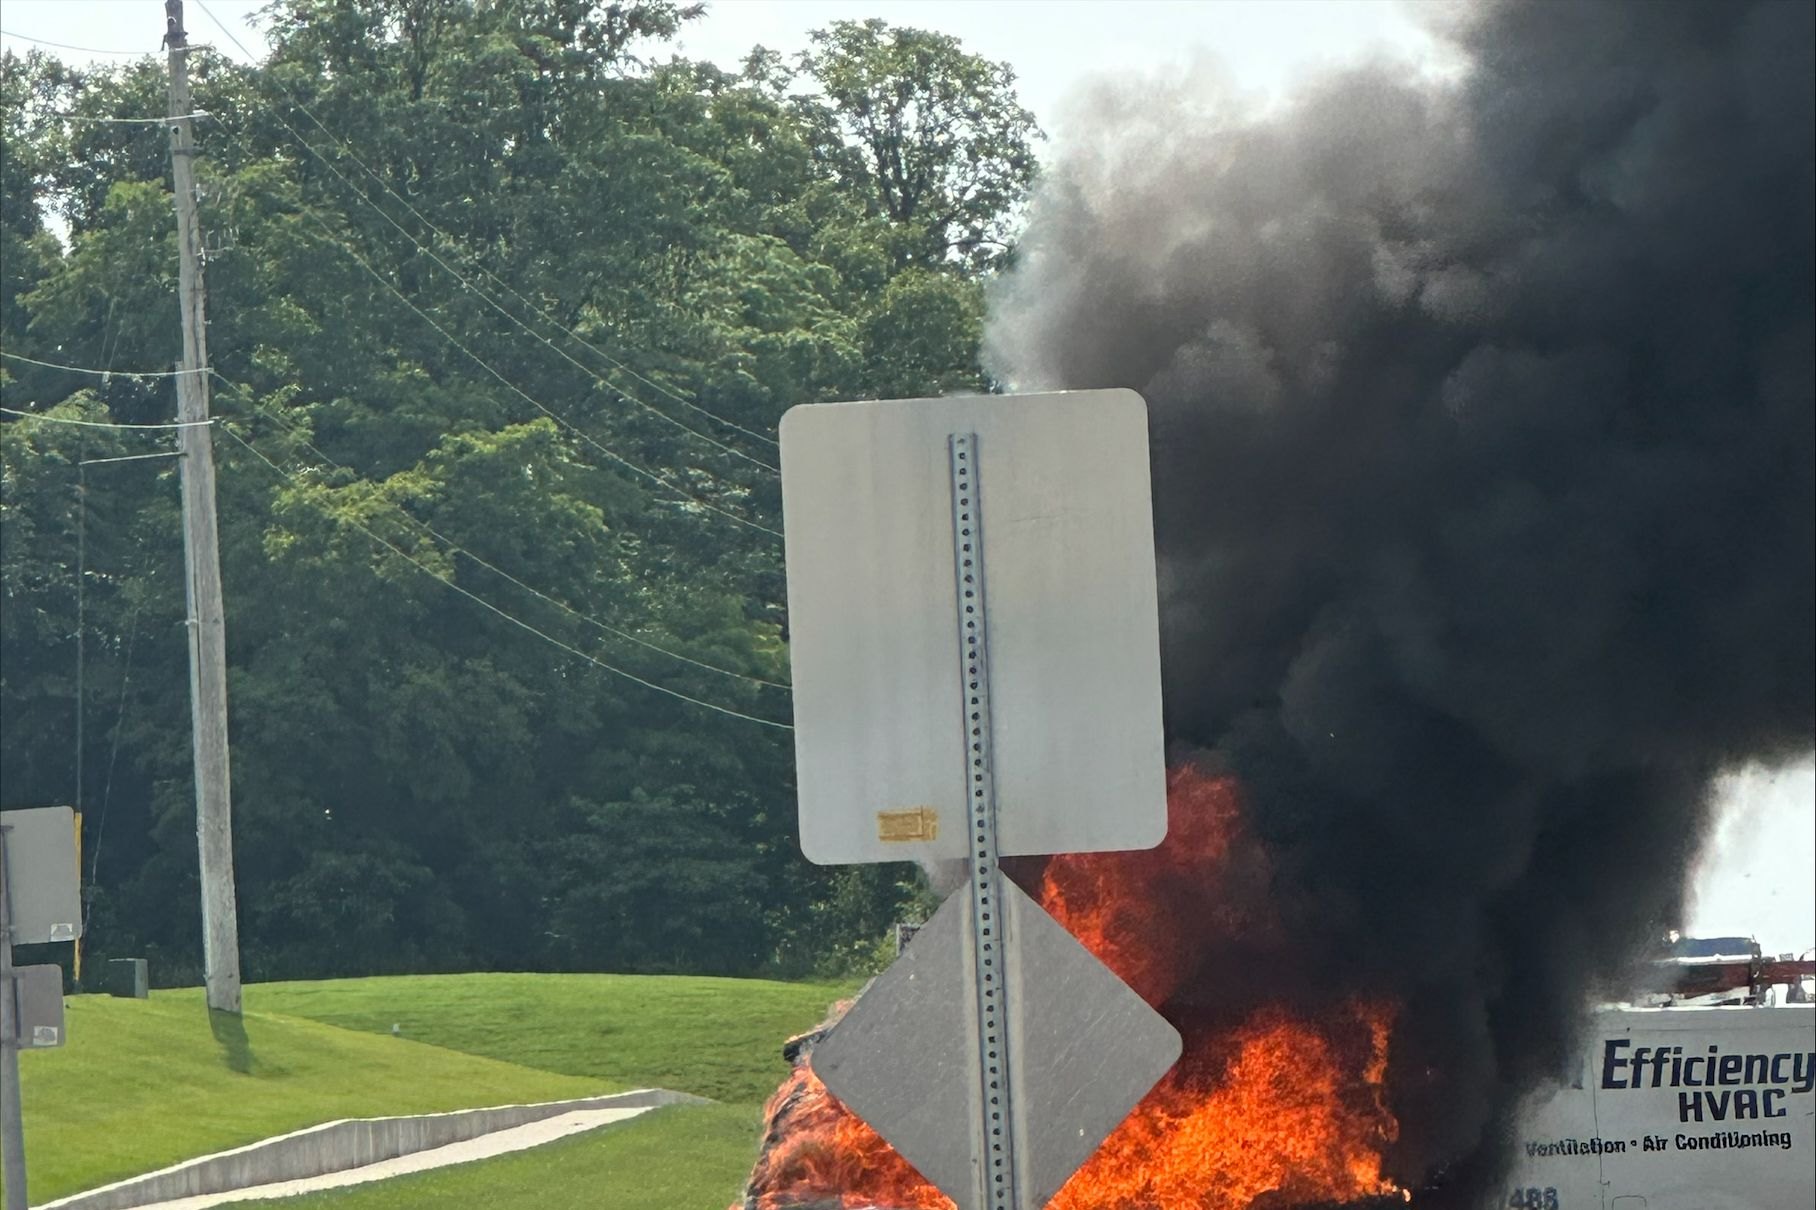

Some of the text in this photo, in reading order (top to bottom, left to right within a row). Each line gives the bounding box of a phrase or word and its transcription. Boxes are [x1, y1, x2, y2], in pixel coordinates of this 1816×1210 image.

[1601, 1039, 1815, 1094] Efficiency
[1678, 1088, 1787, 1123] HVAC
[1525, 1130, 1792, 1157] Ventilation Air Conditioning
